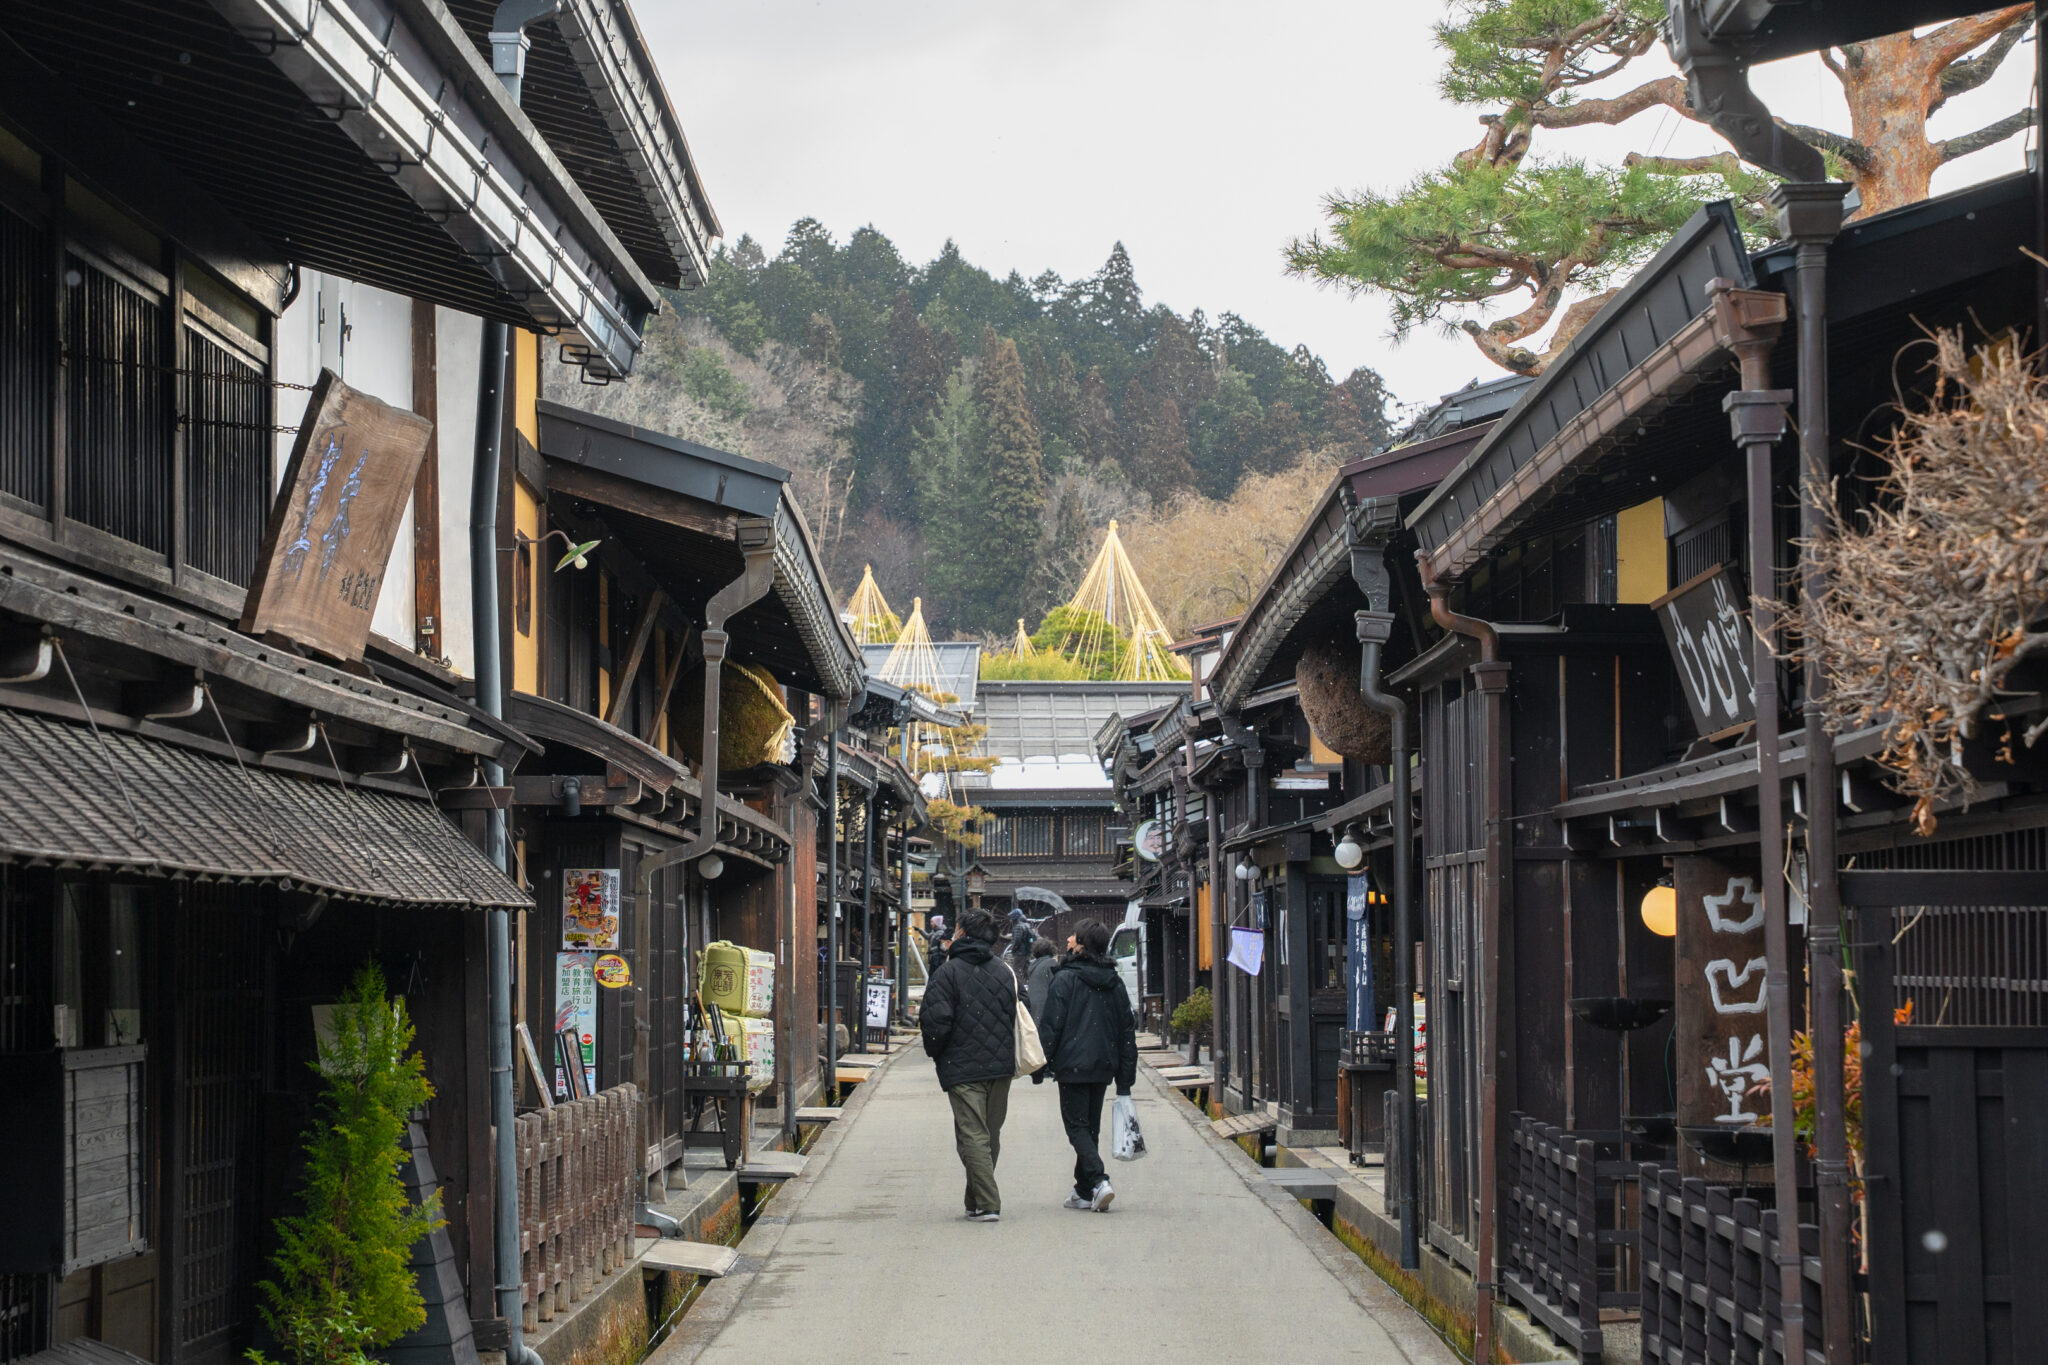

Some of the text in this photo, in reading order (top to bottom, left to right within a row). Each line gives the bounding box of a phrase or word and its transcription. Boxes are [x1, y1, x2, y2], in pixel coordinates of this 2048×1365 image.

[561, 968, 571, 996] 加盟店
[583, 968, 593, 1005] 飛騨高山
[1703, 876, 1770, 1124] 凸凹堂
